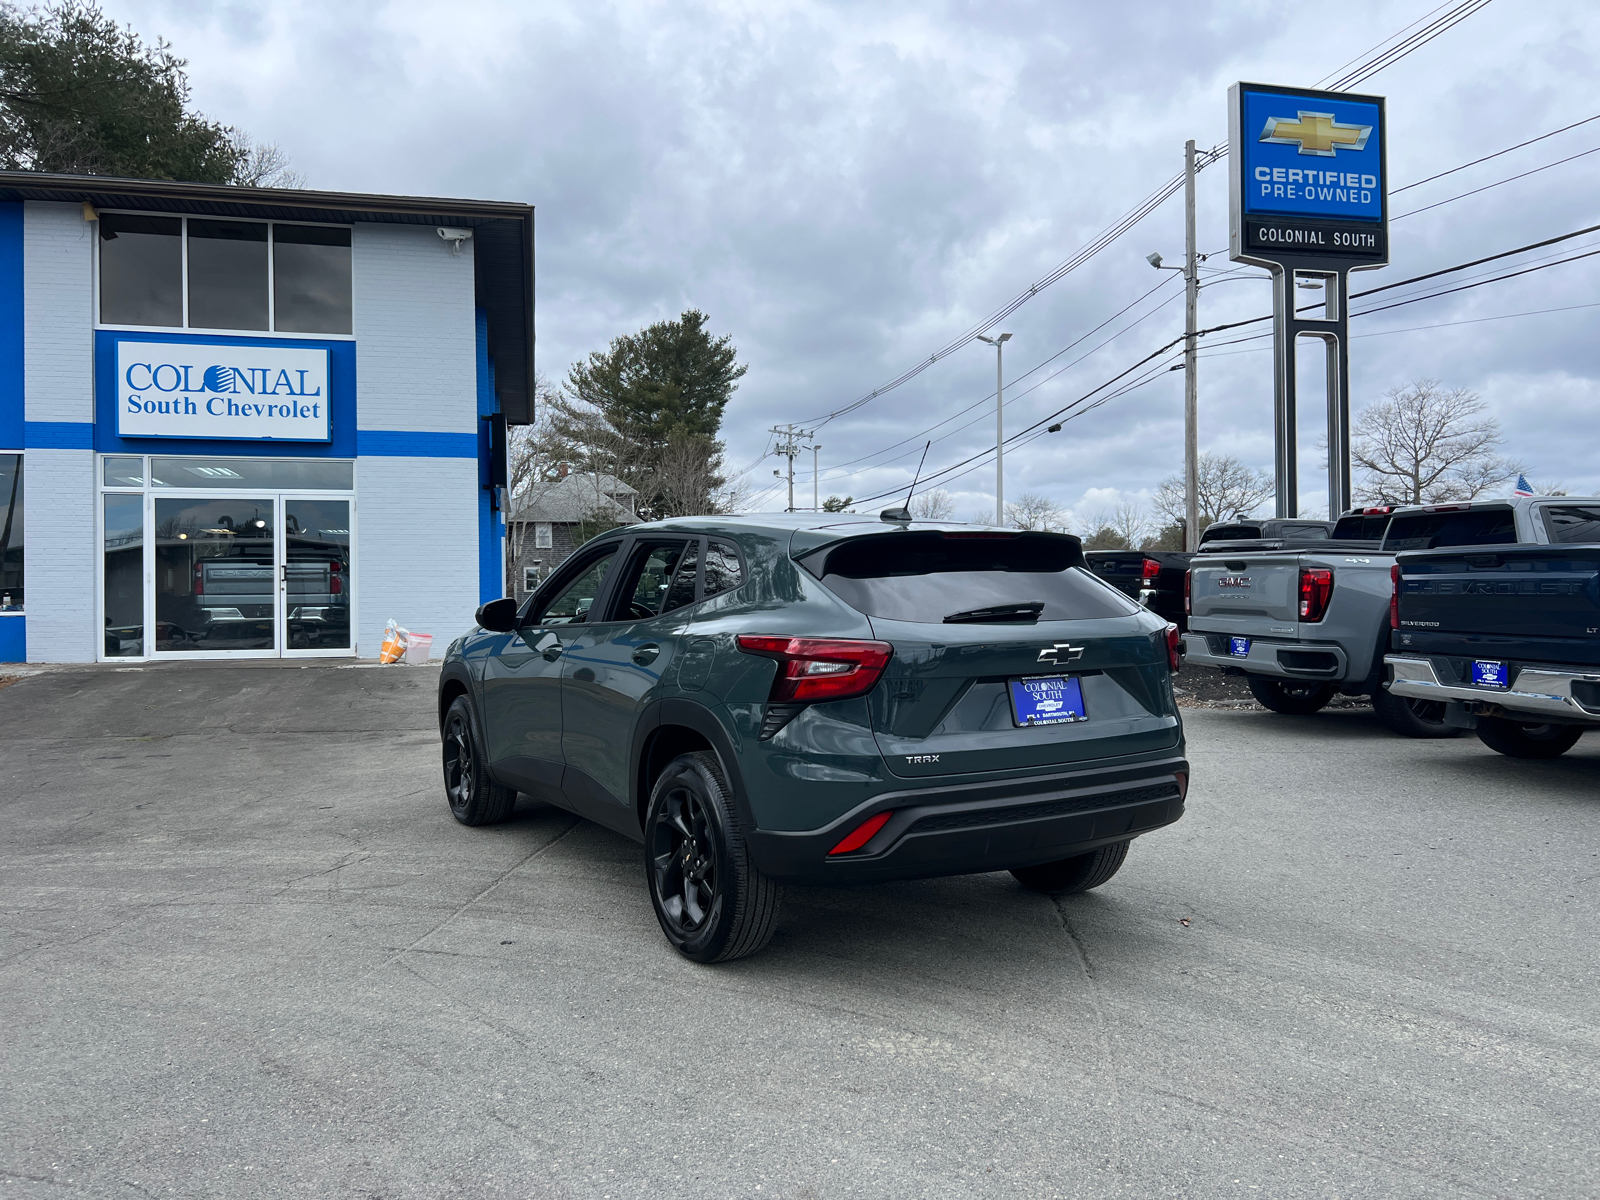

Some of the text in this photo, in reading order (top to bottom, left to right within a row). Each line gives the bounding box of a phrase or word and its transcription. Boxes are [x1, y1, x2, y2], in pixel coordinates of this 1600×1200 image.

[1255, 166, 1377, 189] CERTIFIED
[1261, 183, 1371, 204] PRE-OWNED
[1259, 227, 1375, 247] COLONIAL SOUTH
[126, 362, 320, 397] COLONIAL
[127, 394, 321, 419] South Chevrolet
[1218, 577, 1252, 588] GMC
[1024, 681, 1068, 693] COLONIAL
[1032, 690, 1063, 701] SOUTH
[905, 754, 940, 764] TRAX
